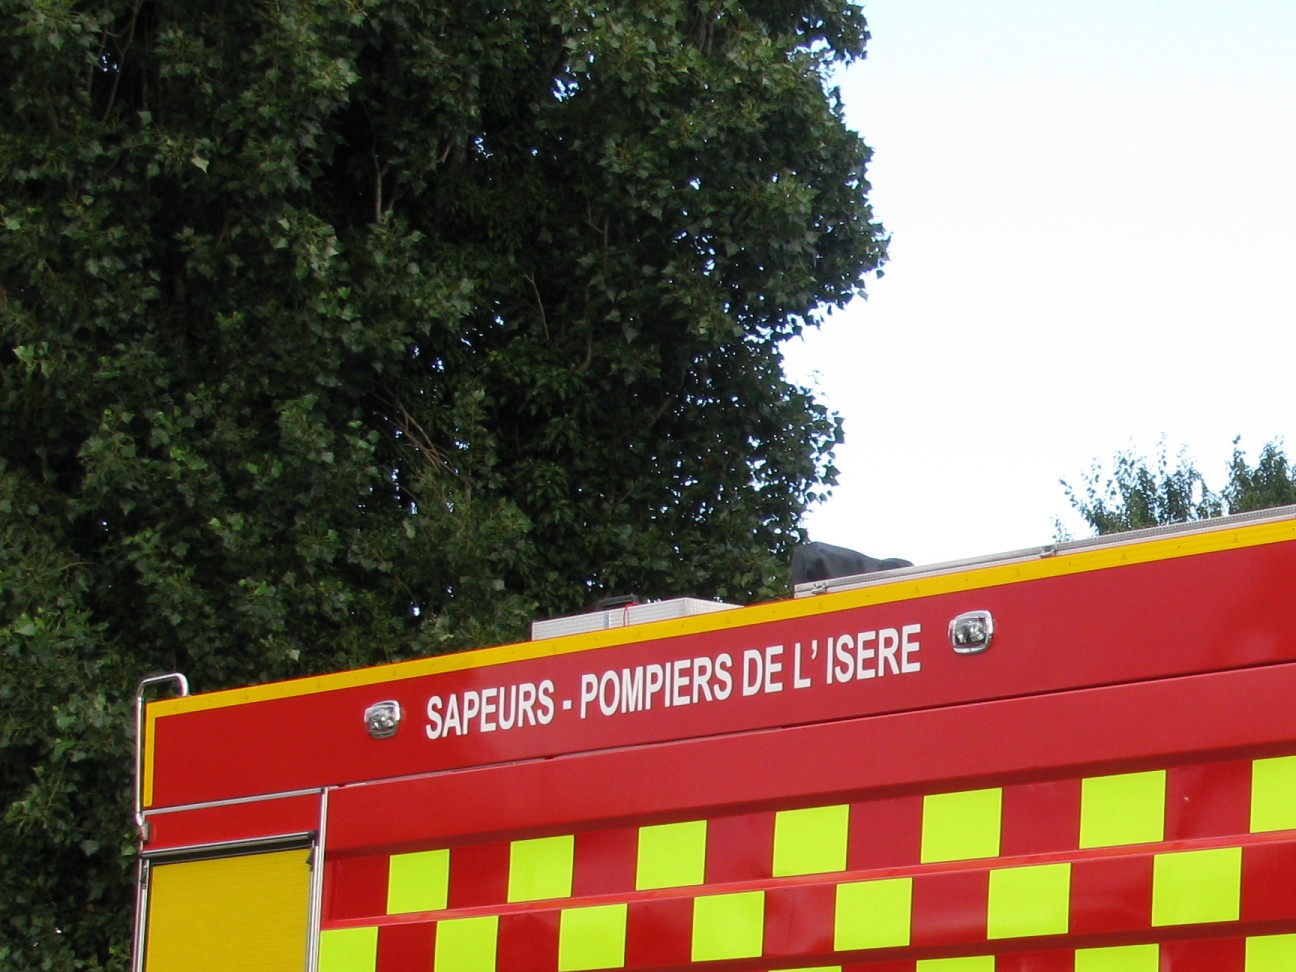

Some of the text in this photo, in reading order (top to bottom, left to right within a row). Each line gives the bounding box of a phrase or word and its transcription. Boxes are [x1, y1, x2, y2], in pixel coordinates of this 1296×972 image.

[425, 679, 555, 740] SAPEURS
[580, 652, 733, 719] POMPIERS
[742, 644, 784, 697] DE
